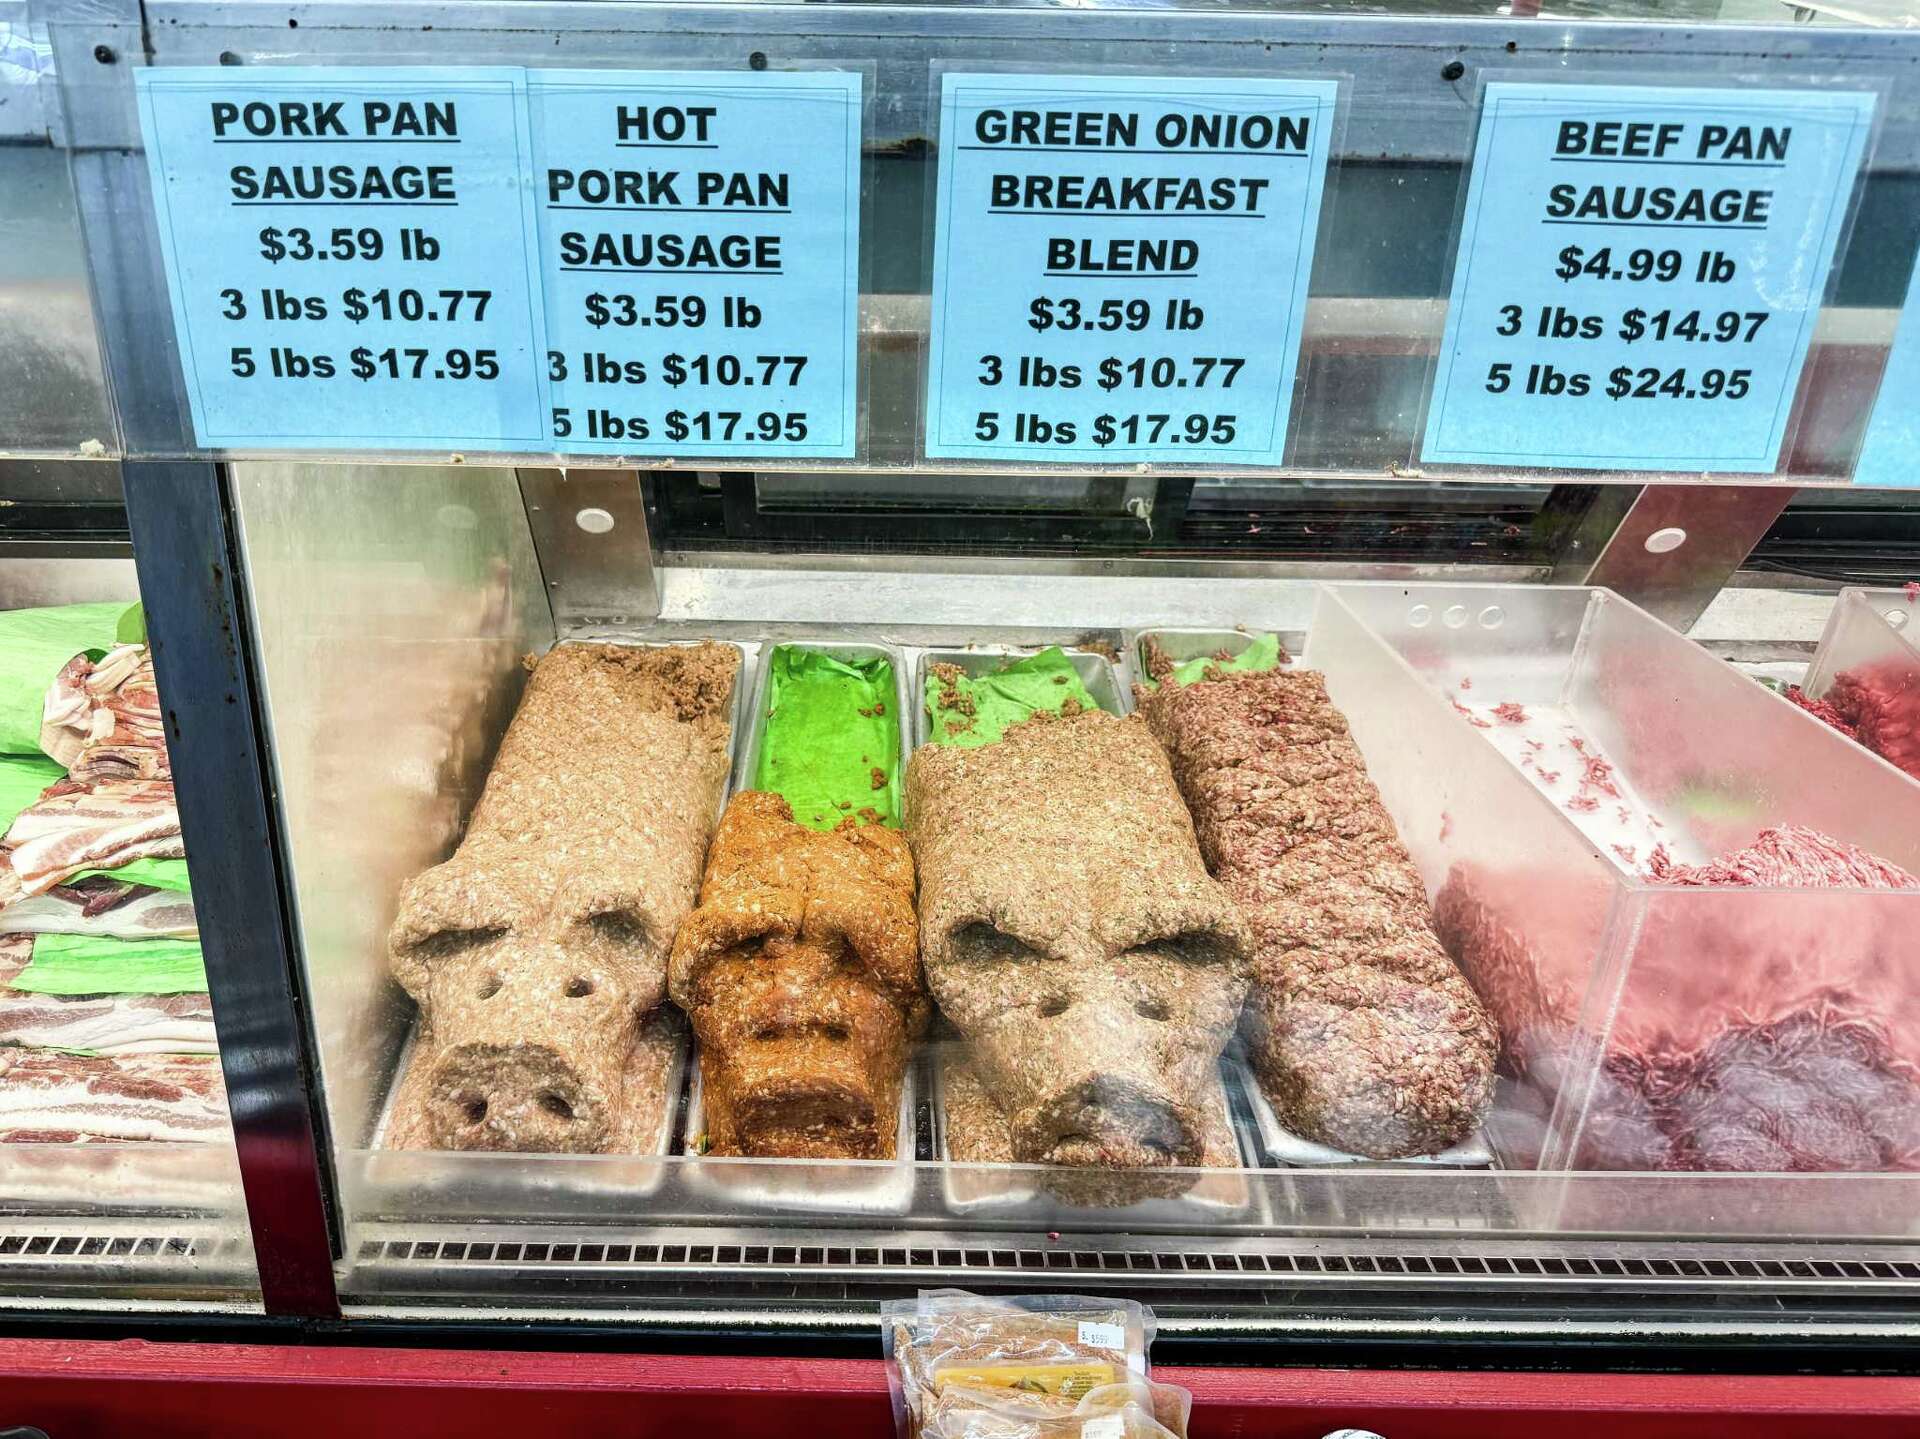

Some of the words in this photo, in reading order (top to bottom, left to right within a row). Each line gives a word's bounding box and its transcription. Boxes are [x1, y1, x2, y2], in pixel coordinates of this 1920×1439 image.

[212, 102, 348, 137] PORK
[364, 102, 458, 137] PAN
[616, 105, 717, 142] HOT
[975, 109, 1139, 147] GREEN
[1155, 113, 1311, 151] ONION
[1555, 120, 1684, 158] BEEF
[1696, 125, 1792, 160] PAN
[231, 165, 456, 201] SAUSAGE
[547, 168, 682, 205] PORK
[697, 172, 790, 207] PAN
[991, 174, 1270, 212] BREAKFAST
[1546, 184, 1773, 223] SAUSAGE
[260, 225, 384, 264] $3.59
[401, 228, 441, 262] lb
[560, 232, 782, 269] SAUSAGE
[1046, 238, 1199, 274] BLEND
[1555, 244, 1682, 283] $4.99
[1695, 250, 1736, 285] lb
[221, 288, 247, 321] 3
[261, 289, 328, 322] lbs
[343, 287, 492, 326] $10.77
[585, 291, 707, 330] $3.59
[723, 296, 763, 329] lb
[1027, 295, 1151, 334] $3.59
[1165, 299, 1205, 332] lb
[1496, 304, 1523, 337] 3
[1537, 306, 1605, 340] lbs
[1618, 307, 1770, 345] $14.97
[232, 347, 256, 378] 5
[271, 347, 336, 380] lbs
[350, 346, 500, 384] $17.95
[547, 350, 568, 382] 3
[583, 352, 648, 385] lbs
[662, 352, 809, 389] $10.77
[978, 354, 1003, 386] 3
[1019, 355, 1082, 389] lbs
[1097, 355, 1247, 393] $10.77
[1485, 363, 1513, 394] 5
[1525, 364, 1592, 397] lbs
[1604, 365, 1752, 402] $24.95
[552, 407, 572, 438] 5
[587, 409, 651, 441] lbs
[664, 409, 809, 443] $17.95
[975, 412, 999, 443] 5
[1015, 413, 1078, 445] lbs
[1091, 412, 1238, 448] $17.95
